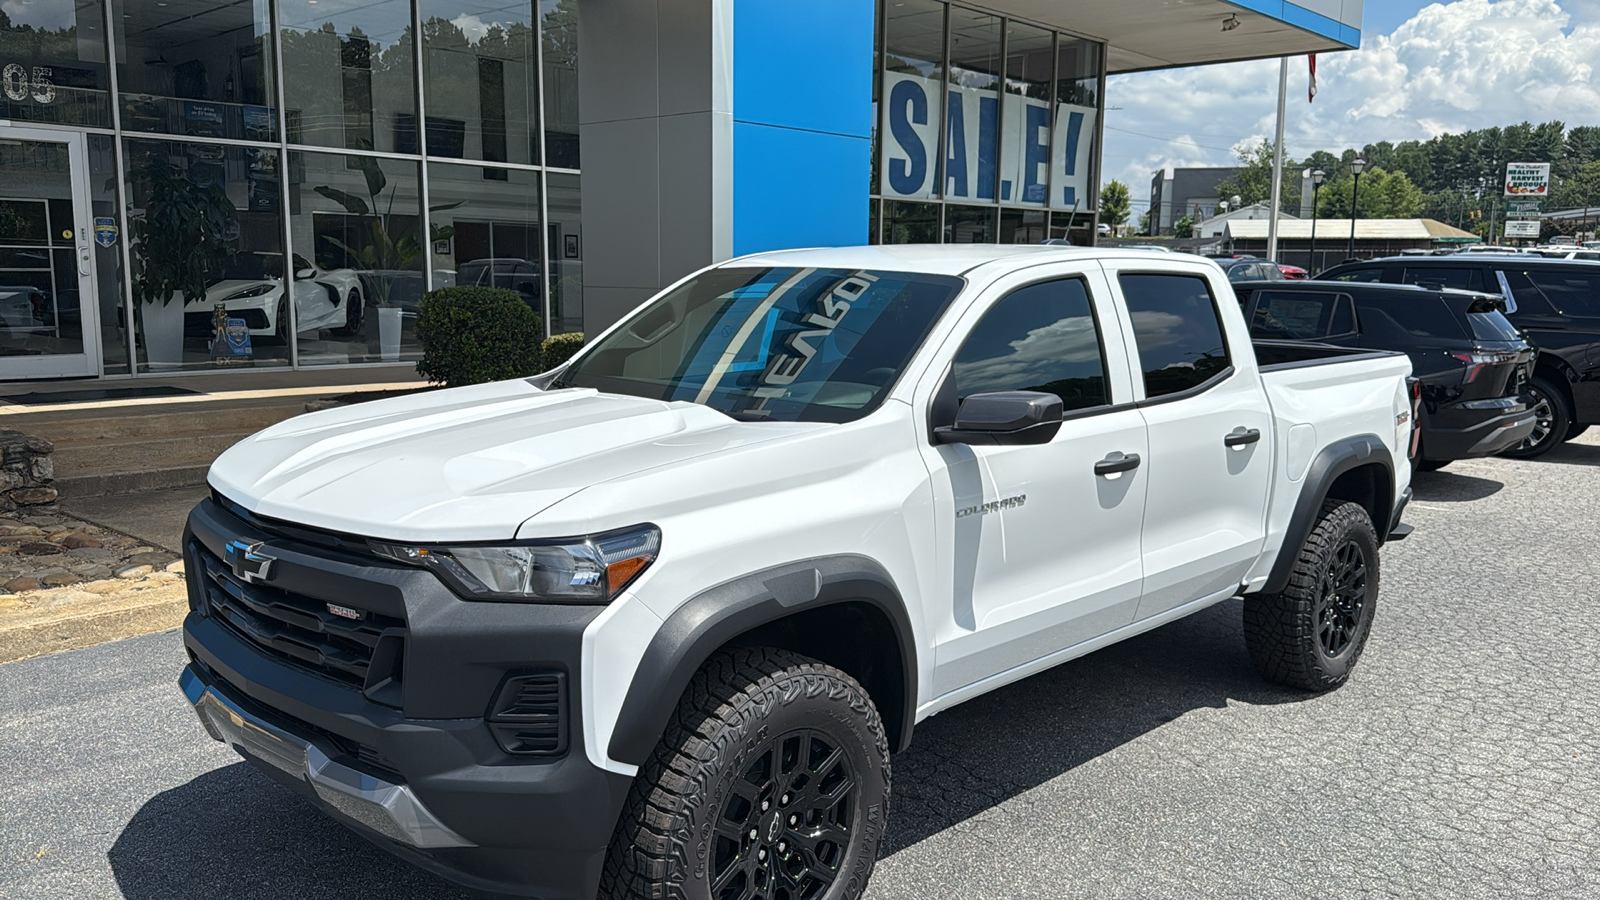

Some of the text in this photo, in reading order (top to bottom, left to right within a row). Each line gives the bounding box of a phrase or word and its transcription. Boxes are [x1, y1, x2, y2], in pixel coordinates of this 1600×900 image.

[0, 63, 56, 104] 05
[888, 79, 1085, 206] SALE!
[956, 494, 1027, 518] COLORADO
